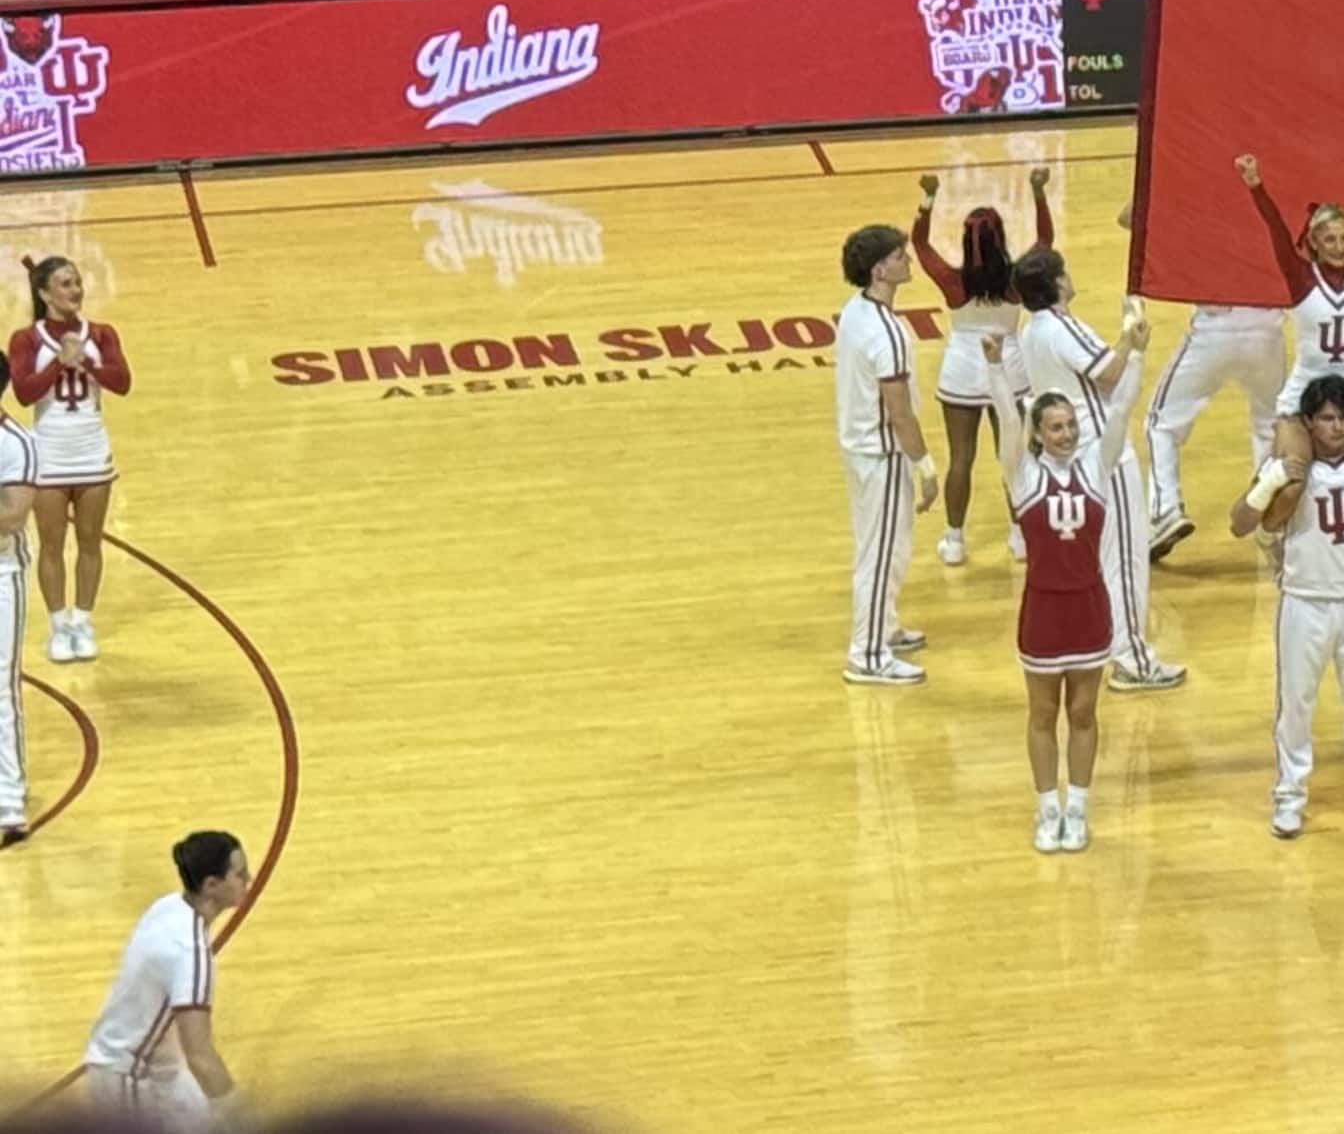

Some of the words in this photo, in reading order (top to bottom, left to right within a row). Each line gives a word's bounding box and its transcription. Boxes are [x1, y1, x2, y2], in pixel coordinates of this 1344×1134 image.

[41, 44, 102, 108] IU
[406, 3, 600, 109] Indiana
[1067, 54, 1124, 71] FOULS
[1068, 84, 1103, 99] TOL
[269, 333, 581, 386] SIMON
[597, 307, 944, 362] SKJOT
[379, 362, 698, 400] ASSEMBLY
[725, 355, 838, 374] HAL
[1046, 489, 1087, 541] IU
